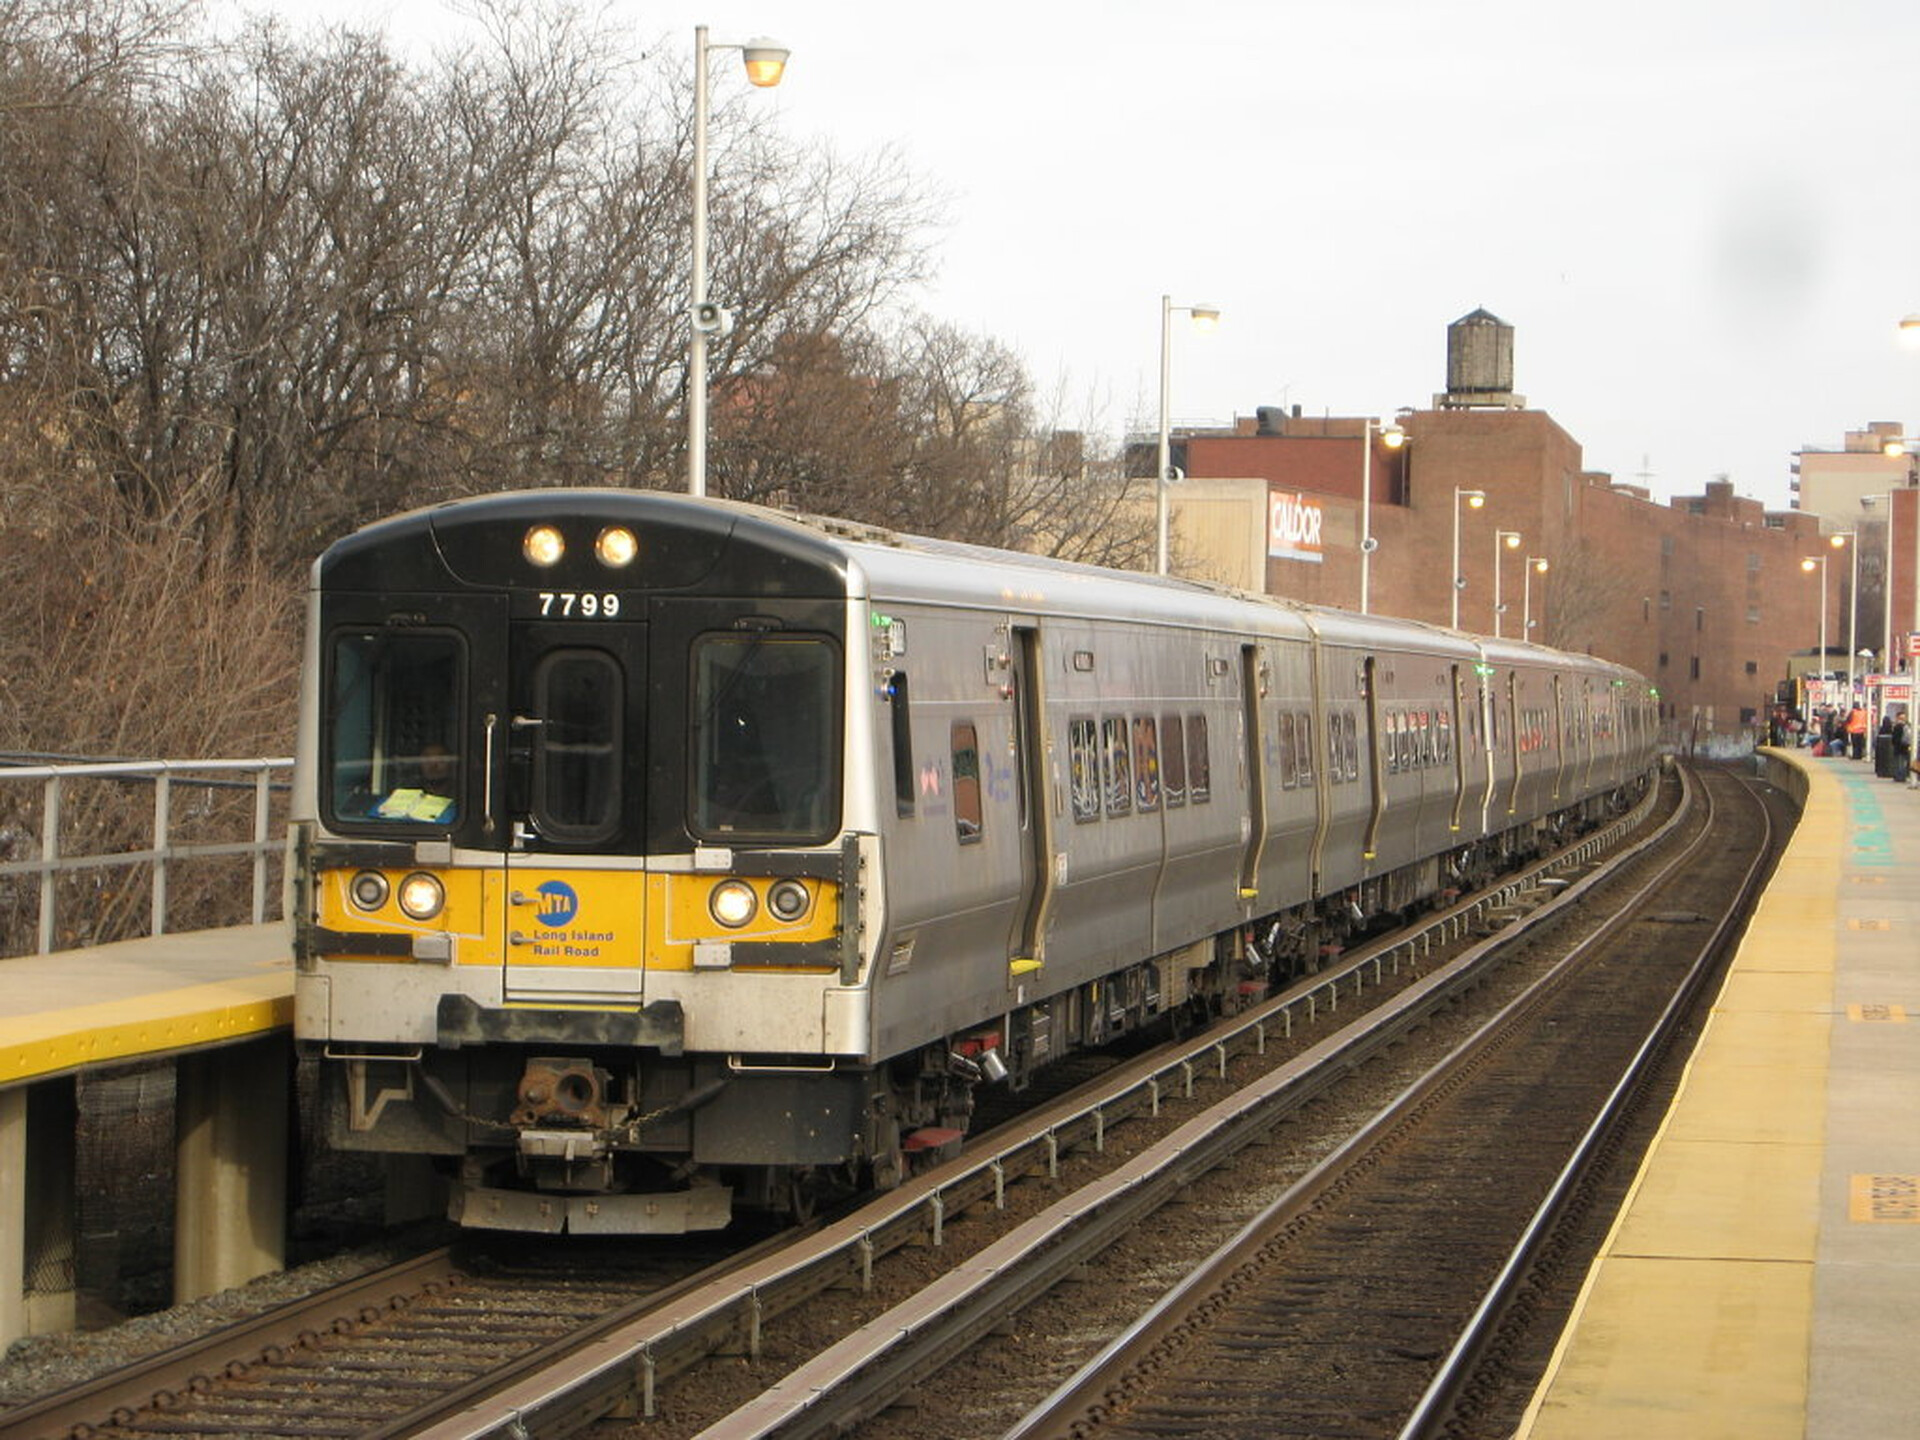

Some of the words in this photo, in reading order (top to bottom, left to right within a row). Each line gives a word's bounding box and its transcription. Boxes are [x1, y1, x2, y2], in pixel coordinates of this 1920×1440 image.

[1272, 495, 1322, 546] CALDOR
[539, 593, 620, 616] 7799
[536, 892, 571, 914] MTA
[533, 930, 567, 942] Long
[572, 930, 614, 942] Island
[533, 945, 560, 956] Rail
[564, 946, 599, 957] Road
